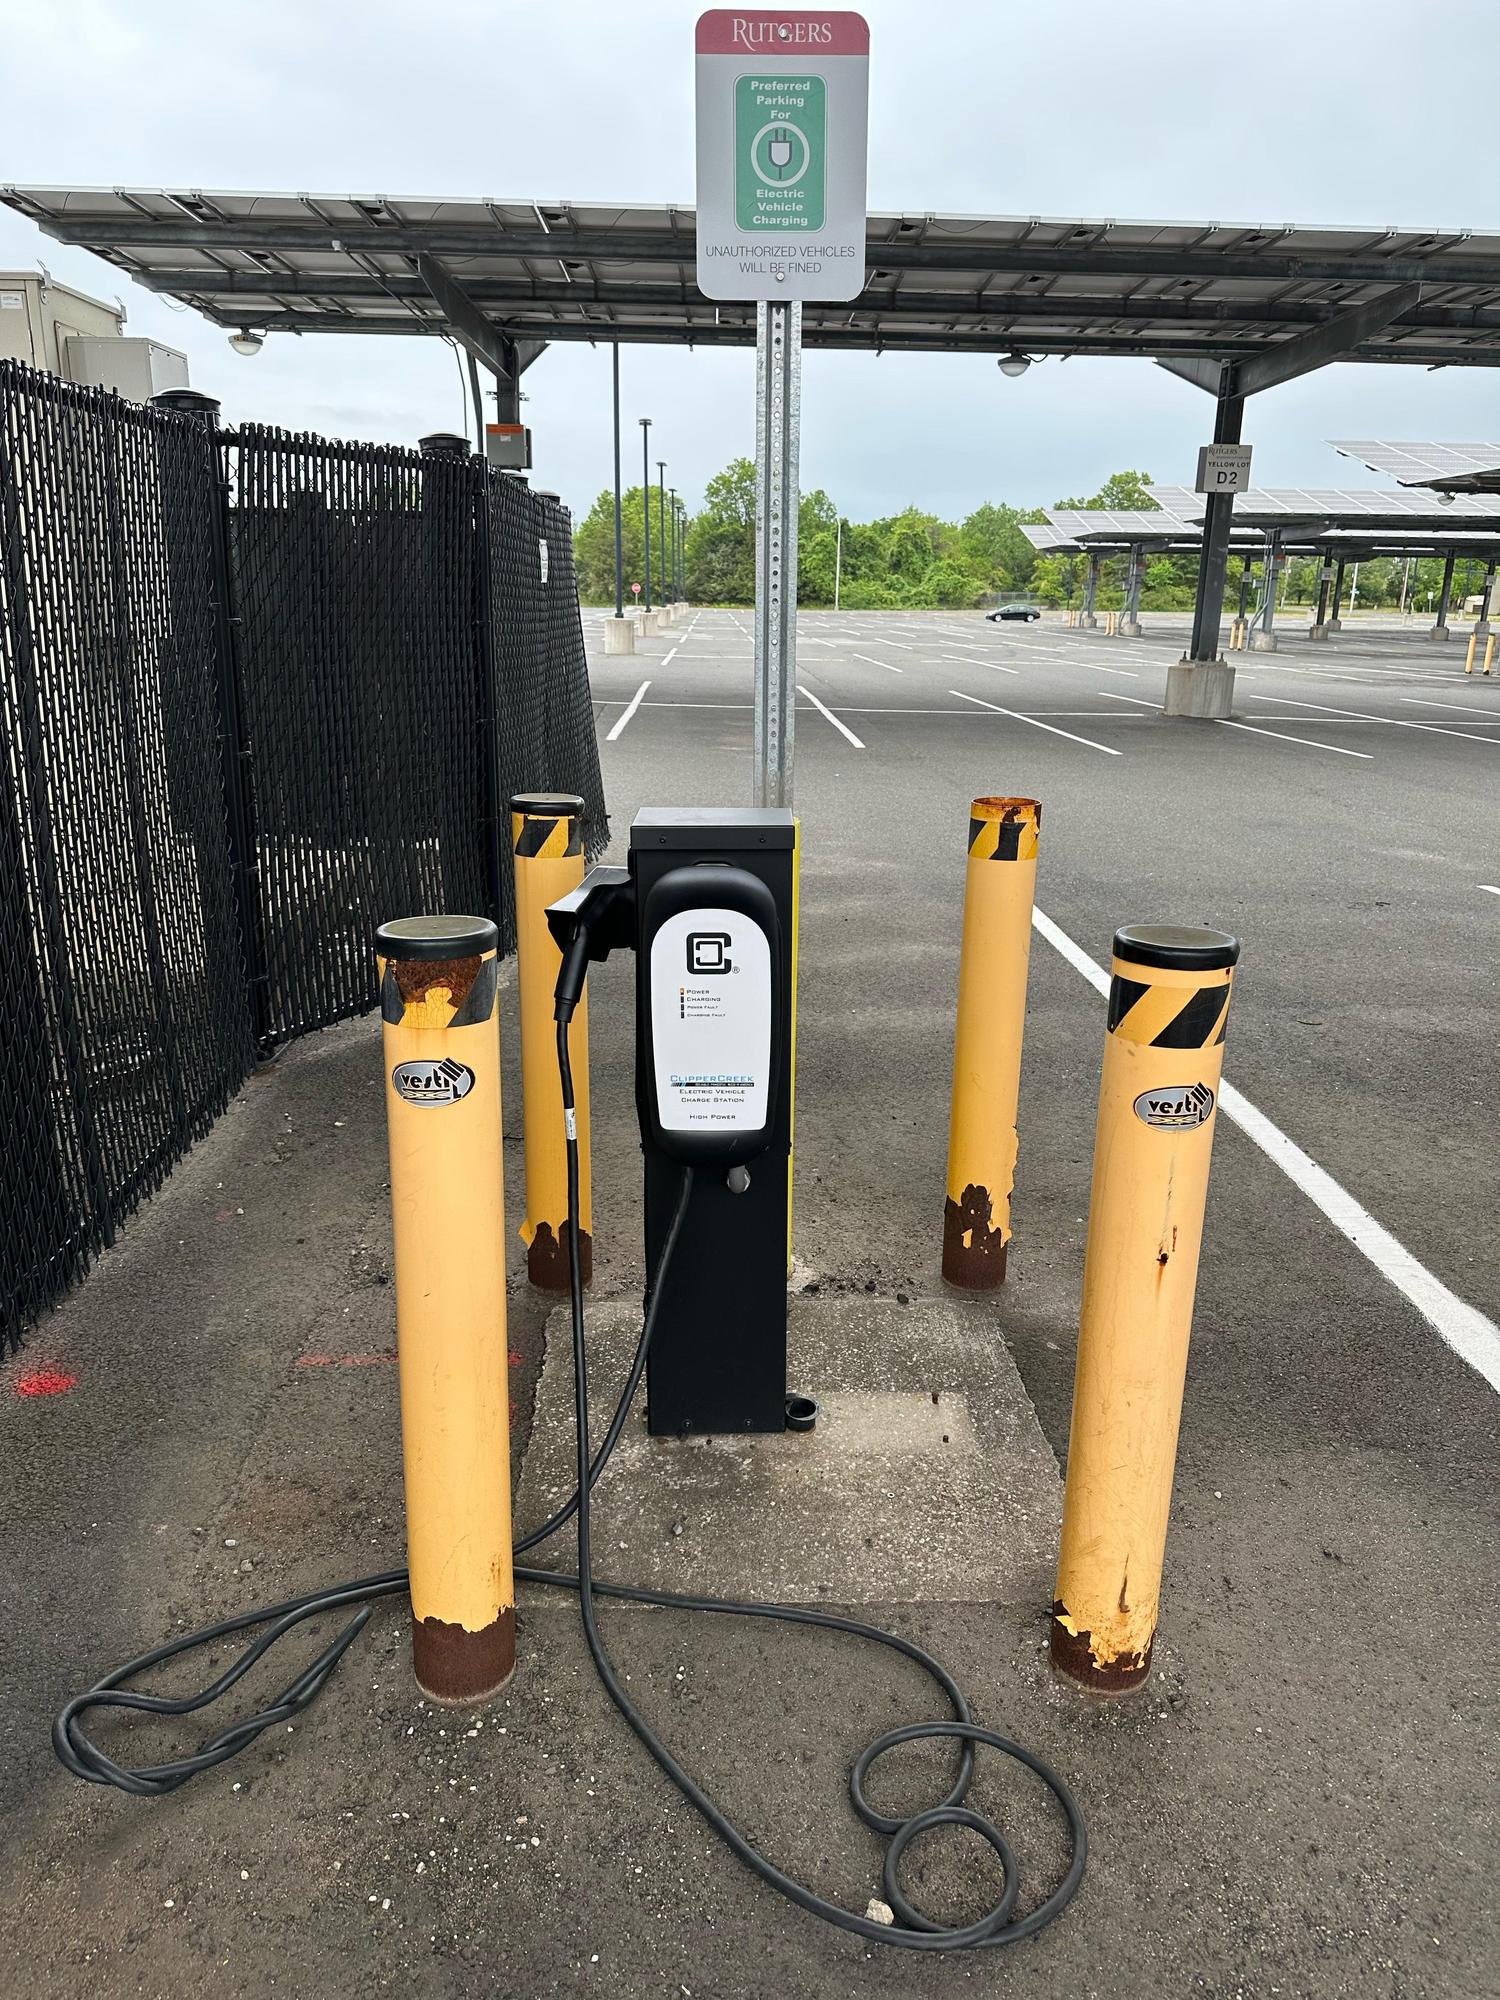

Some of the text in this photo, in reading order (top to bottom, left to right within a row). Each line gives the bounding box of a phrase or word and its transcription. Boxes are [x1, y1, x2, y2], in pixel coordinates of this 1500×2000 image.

[732, 18, 832, 52] RUTGERS
[750, 80, 811, 92] Preferred
[756, 95, 805, 107] Parking
[770, 110, 791, 120] For
[756, 188, 805, 199] Electric
[757, 202, 804, 212] Vehicle
[752, 215, 808, 227] Charging
[705, 245, 856, 258] UNAUTHORIZED VEHICLES
[739, 262, 822, 273] WILL BE FINED
[1216, 471, 1238, 485] D2
